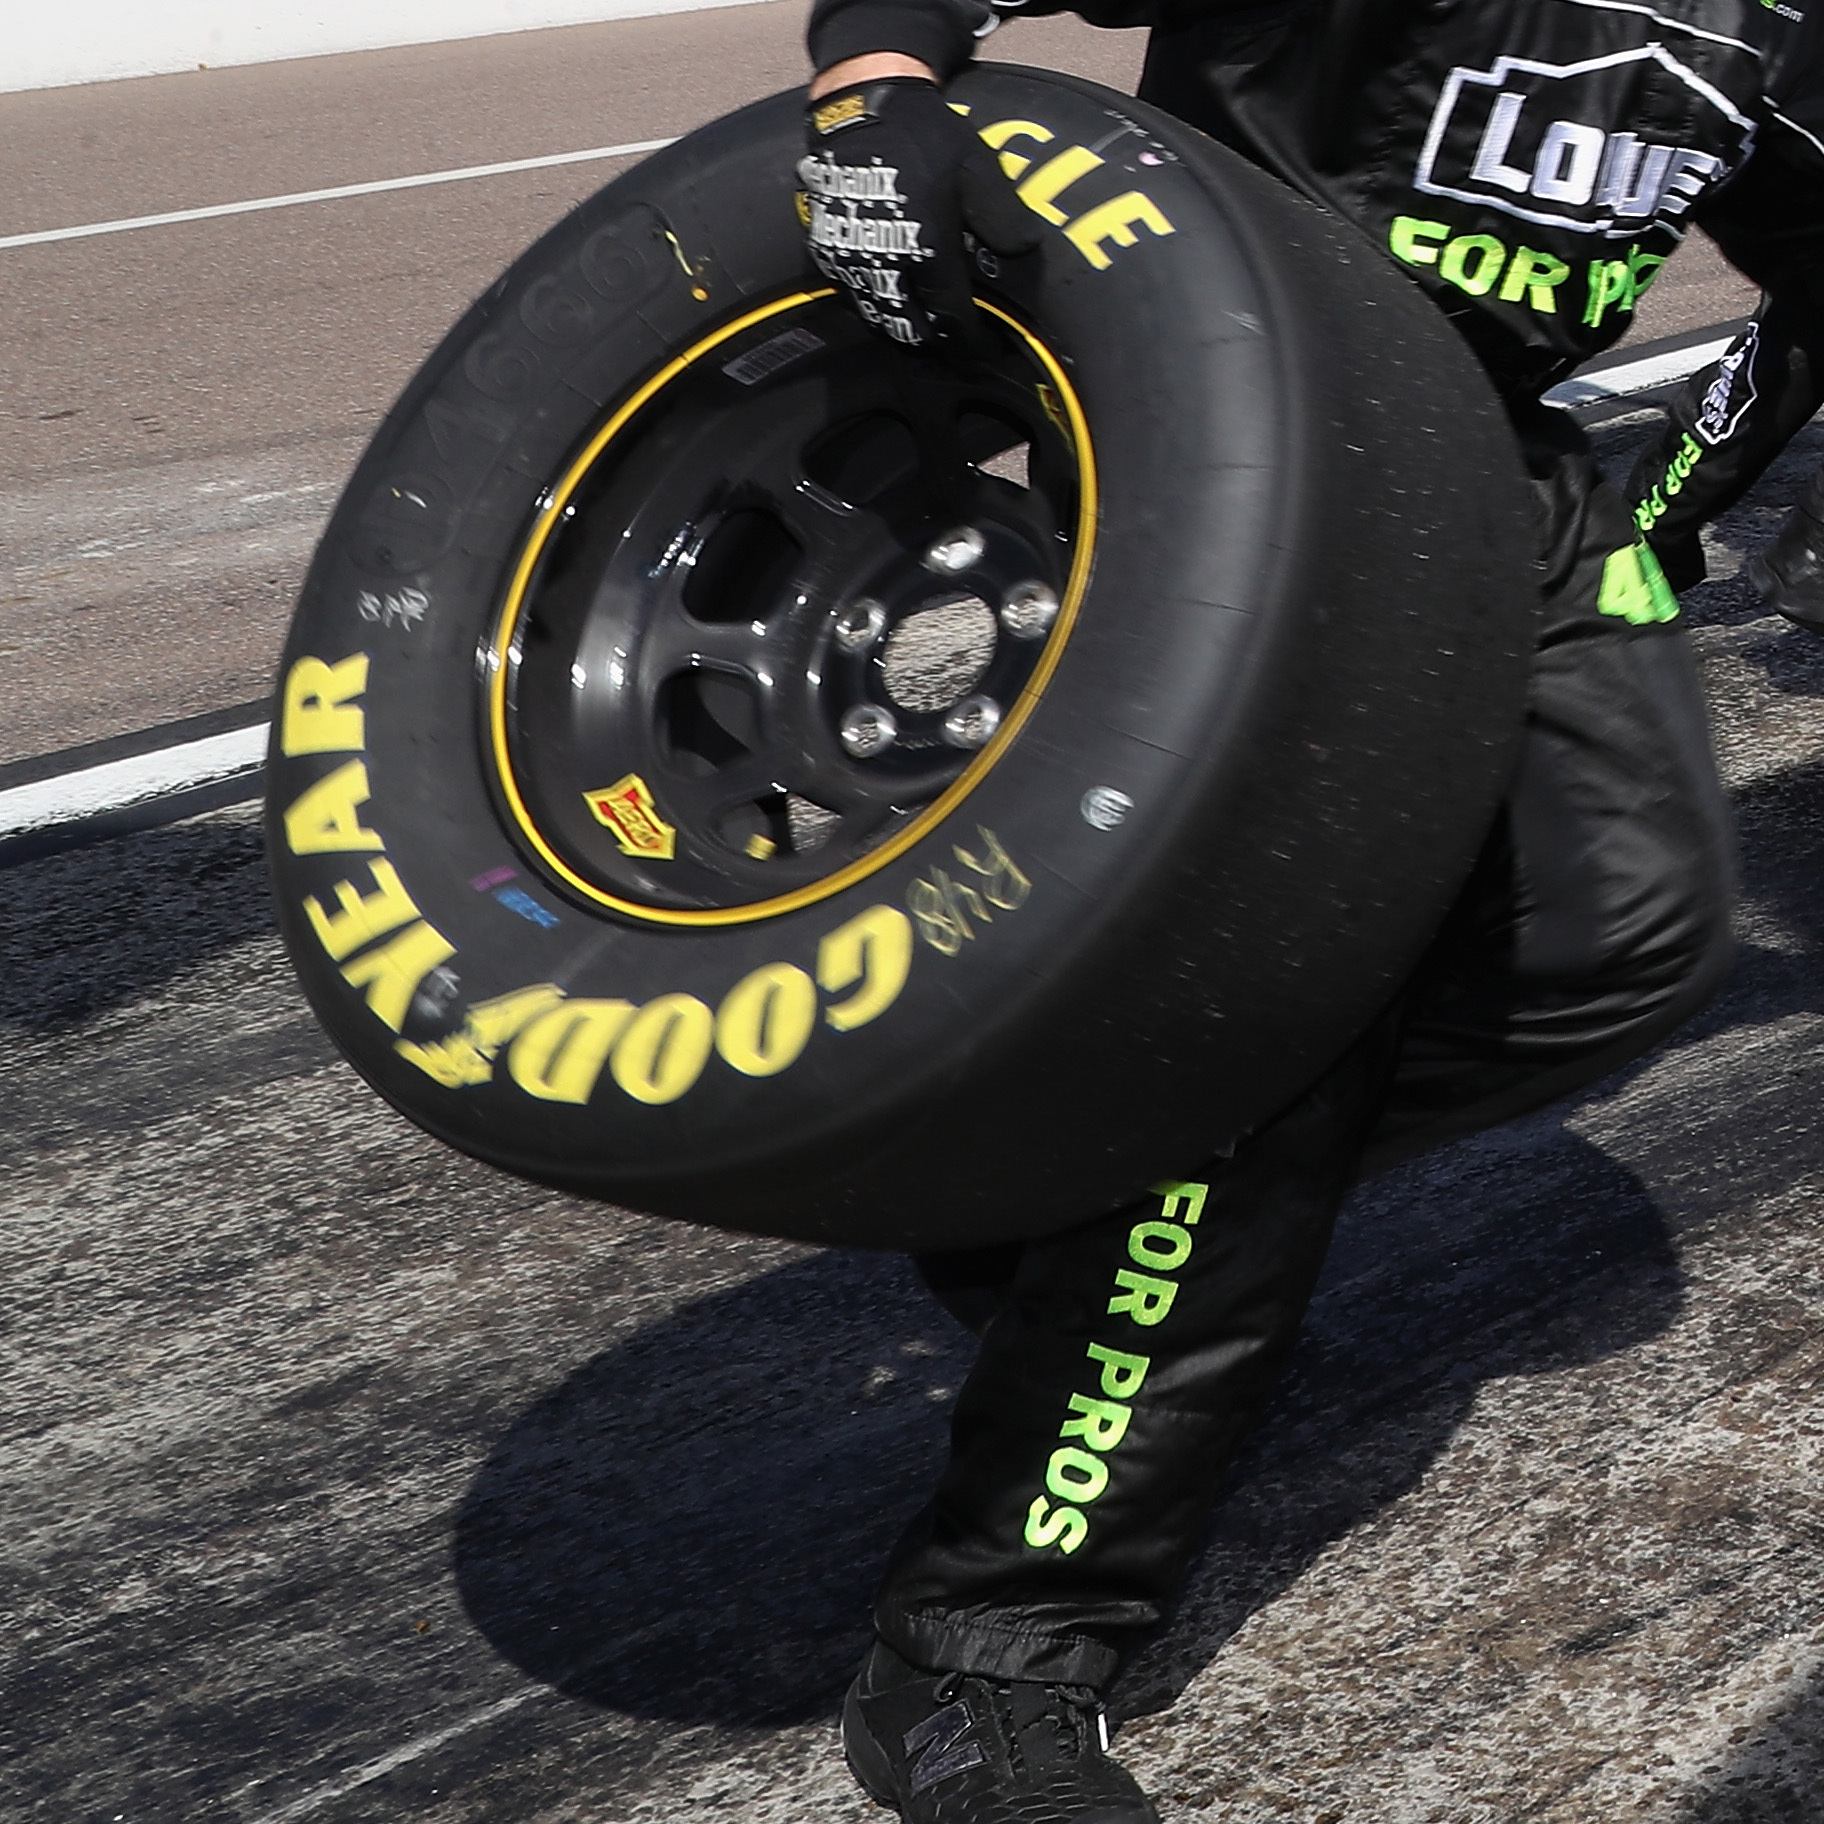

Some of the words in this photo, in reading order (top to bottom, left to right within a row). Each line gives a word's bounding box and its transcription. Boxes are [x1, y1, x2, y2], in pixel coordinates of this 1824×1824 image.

[1389, 215, 1571, 314] FOR
[281, 651, 914, 1106] GOODYEAR
[1106, 1180, 1210, 1328] FOR
[1023, 1341, 1152, 1556] PROS
